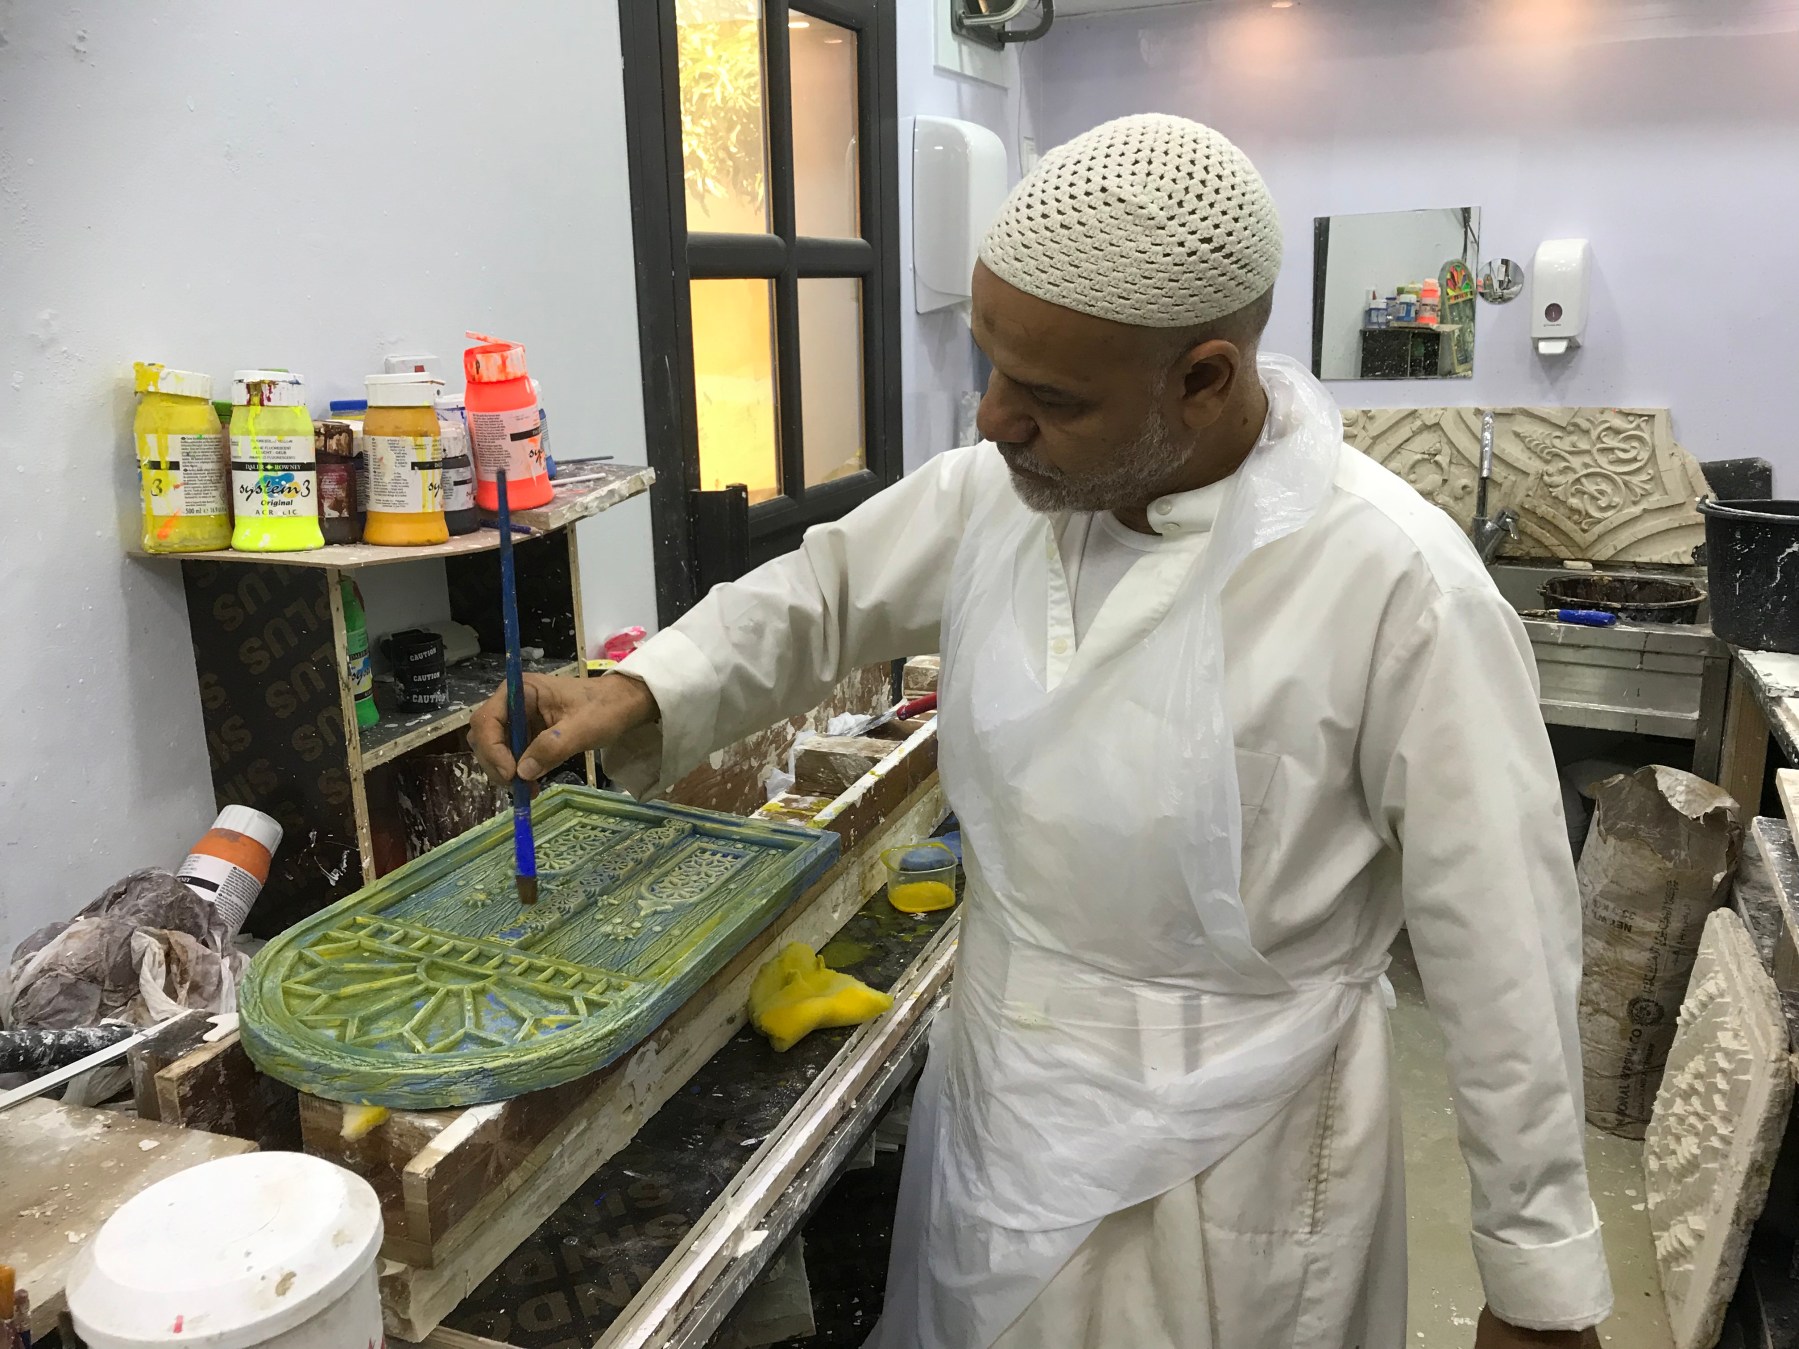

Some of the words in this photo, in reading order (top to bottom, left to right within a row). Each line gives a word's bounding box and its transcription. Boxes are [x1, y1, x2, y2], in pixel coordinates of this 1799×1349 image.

[255, 508, 298, 516] ACRLIC
[409, 647, 437, 662] CAUTION
[413, 672, 440, 682] CAUTION
